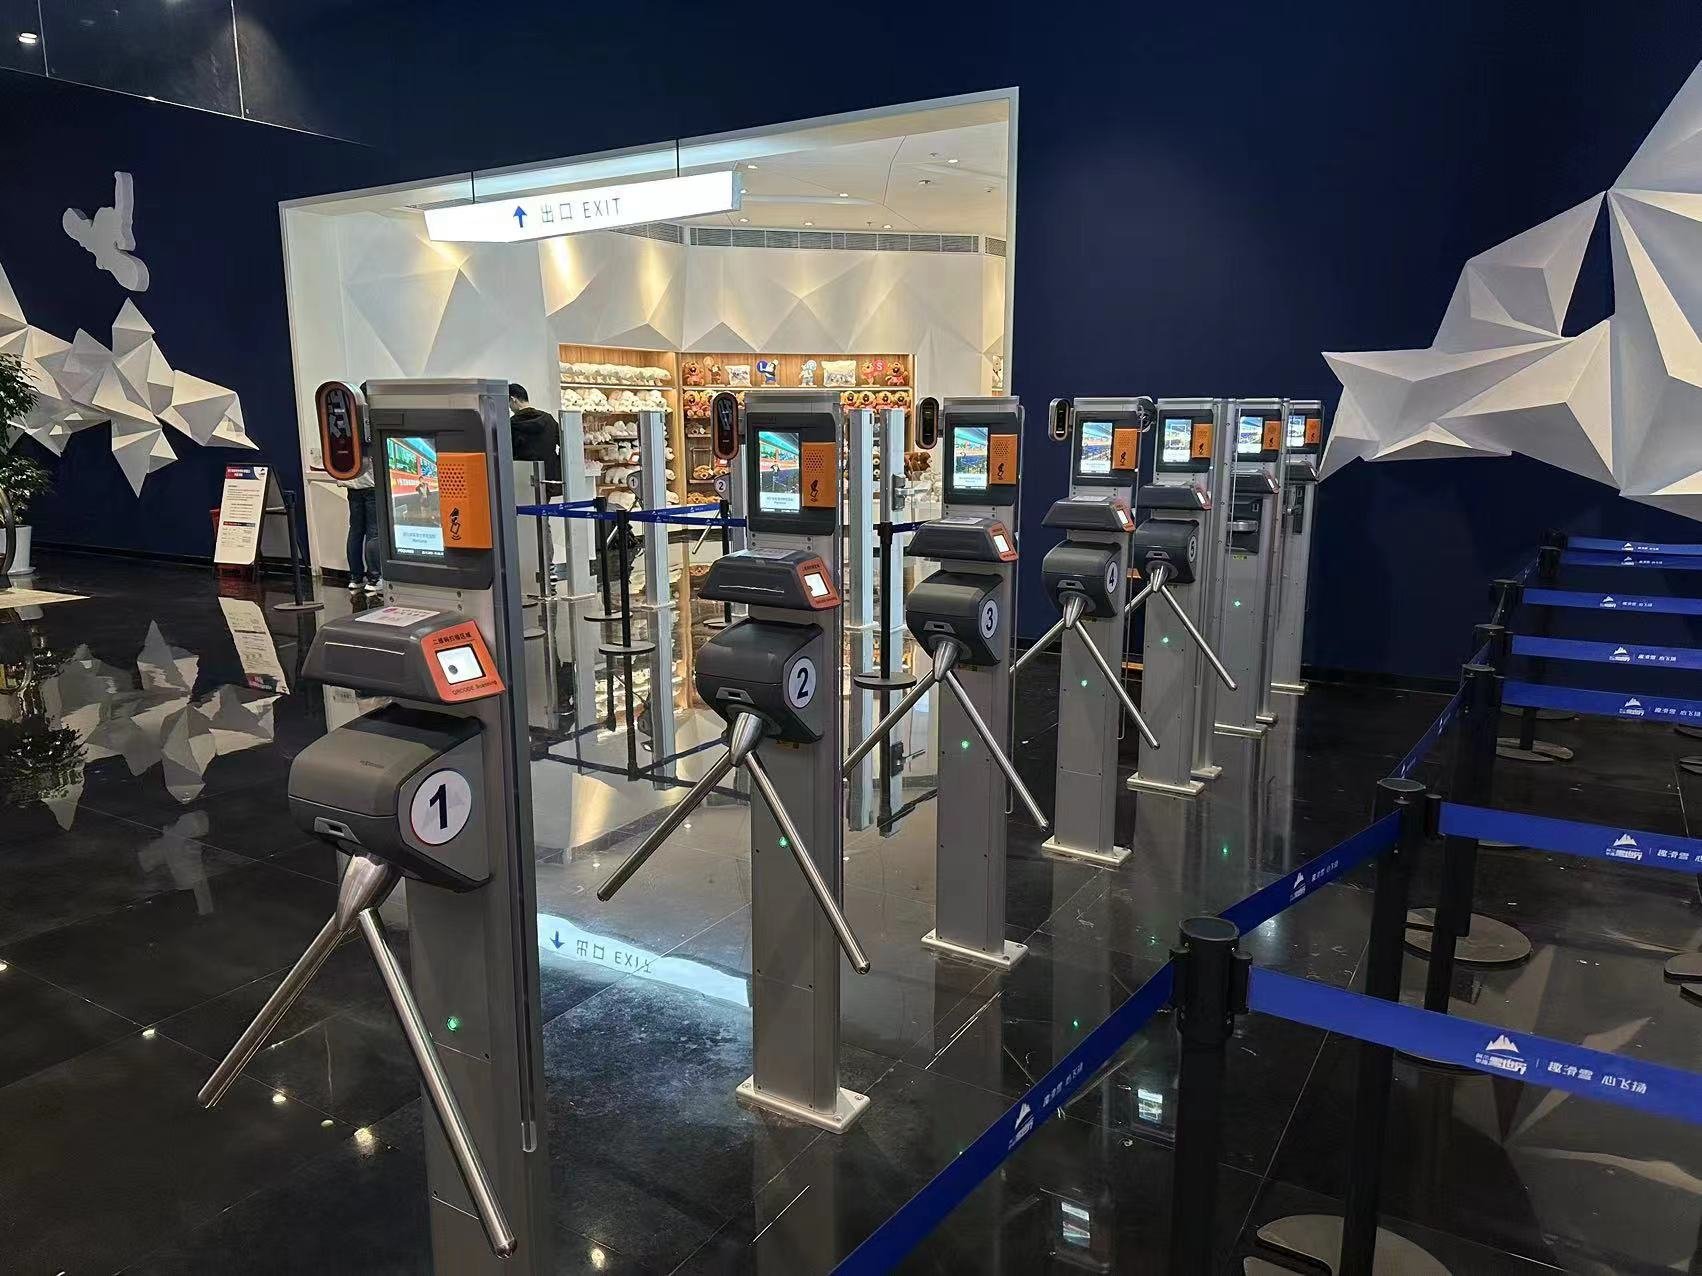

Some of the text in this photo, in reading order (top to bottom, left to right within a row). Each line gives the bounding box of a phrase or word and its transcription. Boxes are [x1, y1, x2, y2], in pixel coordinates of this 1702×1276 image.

[540, 198, 621, 224] 出口 EXIT
[986, 607, 993, 631] 3
[797, 667, 809, 699] 2
[429, 783, 448, 830] 1
